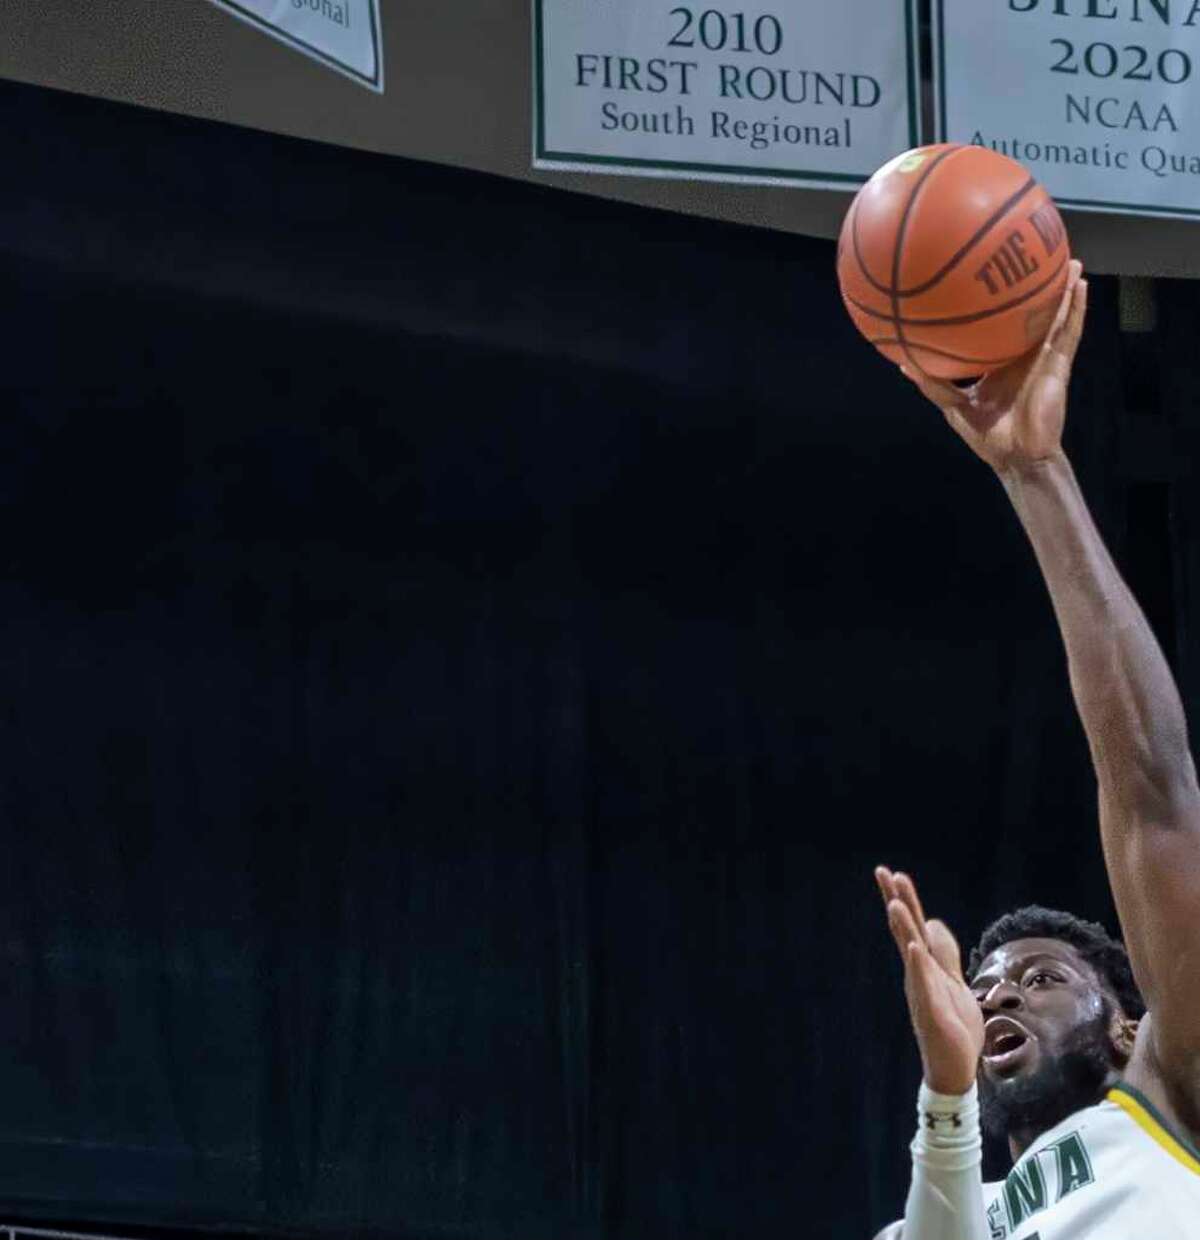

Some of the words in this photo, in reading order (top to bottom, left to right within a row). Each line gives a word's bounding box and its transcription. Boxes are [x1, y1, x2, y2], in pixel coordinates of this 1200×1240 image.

[667, 7, 783, 56] 2010
[574, 53, 698, 95] FIRST
[718, 64, 881, 109] ROUND
[1050, 38, 1193, 84] 2020
[600, 102, 695, 136] South
[710, 110, 852, 150] Regional
[1065, 93, 1179, 132] NCAA
[969, 130, 1128, 170] Automatic
[975, 231, 1039, 295] THE
